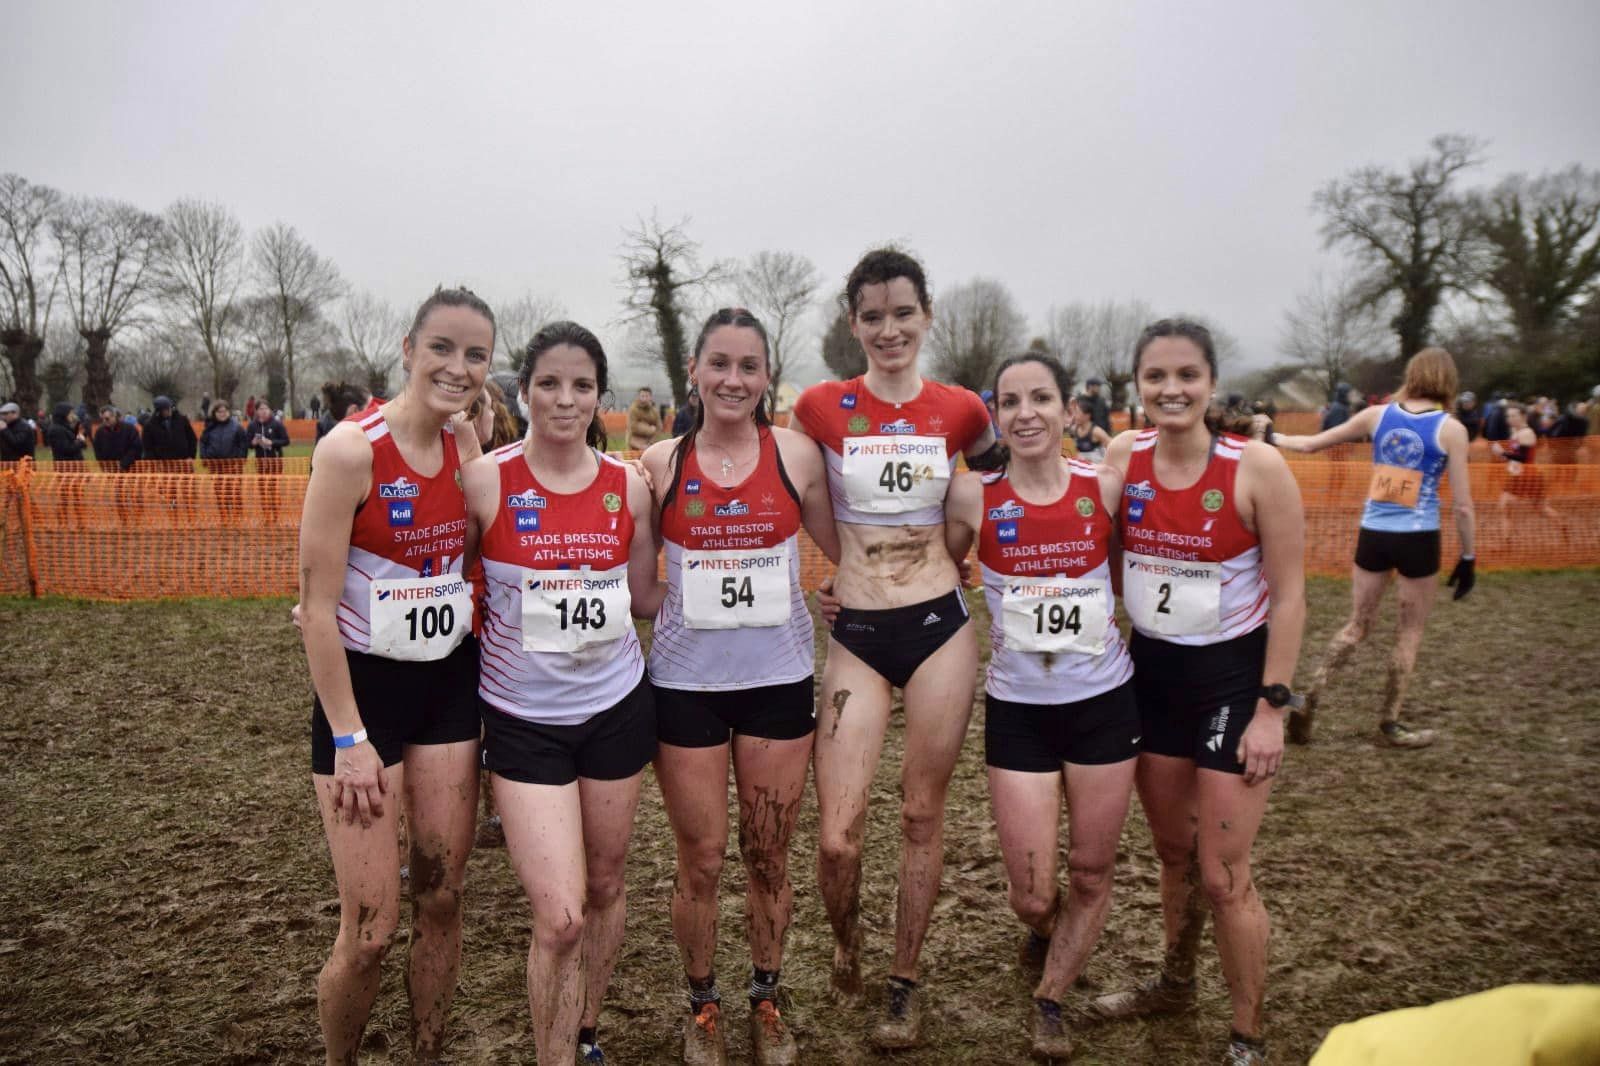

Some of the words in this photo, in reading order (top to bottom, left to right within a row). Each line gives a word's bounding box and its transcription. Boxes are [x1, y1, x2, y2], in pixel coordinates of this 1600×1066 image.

[861, 444, 939, 455] INTERSPORT
[880, 461, 913, 493] 46
[382, 487, 418, 497] Argel
[510, 497, 545, 508] Argel
[392, 509, 412, 520] Krill
[717, 507, 748, 516] Argel
[990, 509, 1022, 519] Argel
[518, 517, 536, 526] Krill
[394, 527, 430, 542] STADE
[690, 525, 722, 536] STADE
[726, 522, 774, 534] BRESTOIS
[998, 527, 1016, 537] Krill
[520, 535, 561, 546] STADE
[564, 533, 620, 546] BRESTOIS
[702, 536, 764, 549] ATHLÉTISME
[1127, 526, 1155, 541] STADE
[1157, 531, 1212, 547] BRESTOIS
[405, 535, 464, 557] ATHLÉTISME
[1002, 545, 1037, 558] STADE
[1040, 540, 1095, 554] BRESTOIS
[1132, 543, 1198, 560] ATHLÉTISME
[533, 547, 614, 561] ATHLÉTISME
[701, 556, 782, 570] INTERSPORT
[1013, 555, 1088, 573] ATHLÉTISME
[1137, 564, 1211, 579] INTERSPORT
[393, 582, 464, 600] INTERSPORT
[542, 578, 620, 591] INTERSPORT
[1021, 585, 1101, 598] INTERSPORT
[721, 576, 755, 609] 54
[1157, 583, 1171, 614] 2
[555, 597, 606, 630] 143
[1033, 603, 1082, 635] 194
[405, 604, 455, 640] 100
